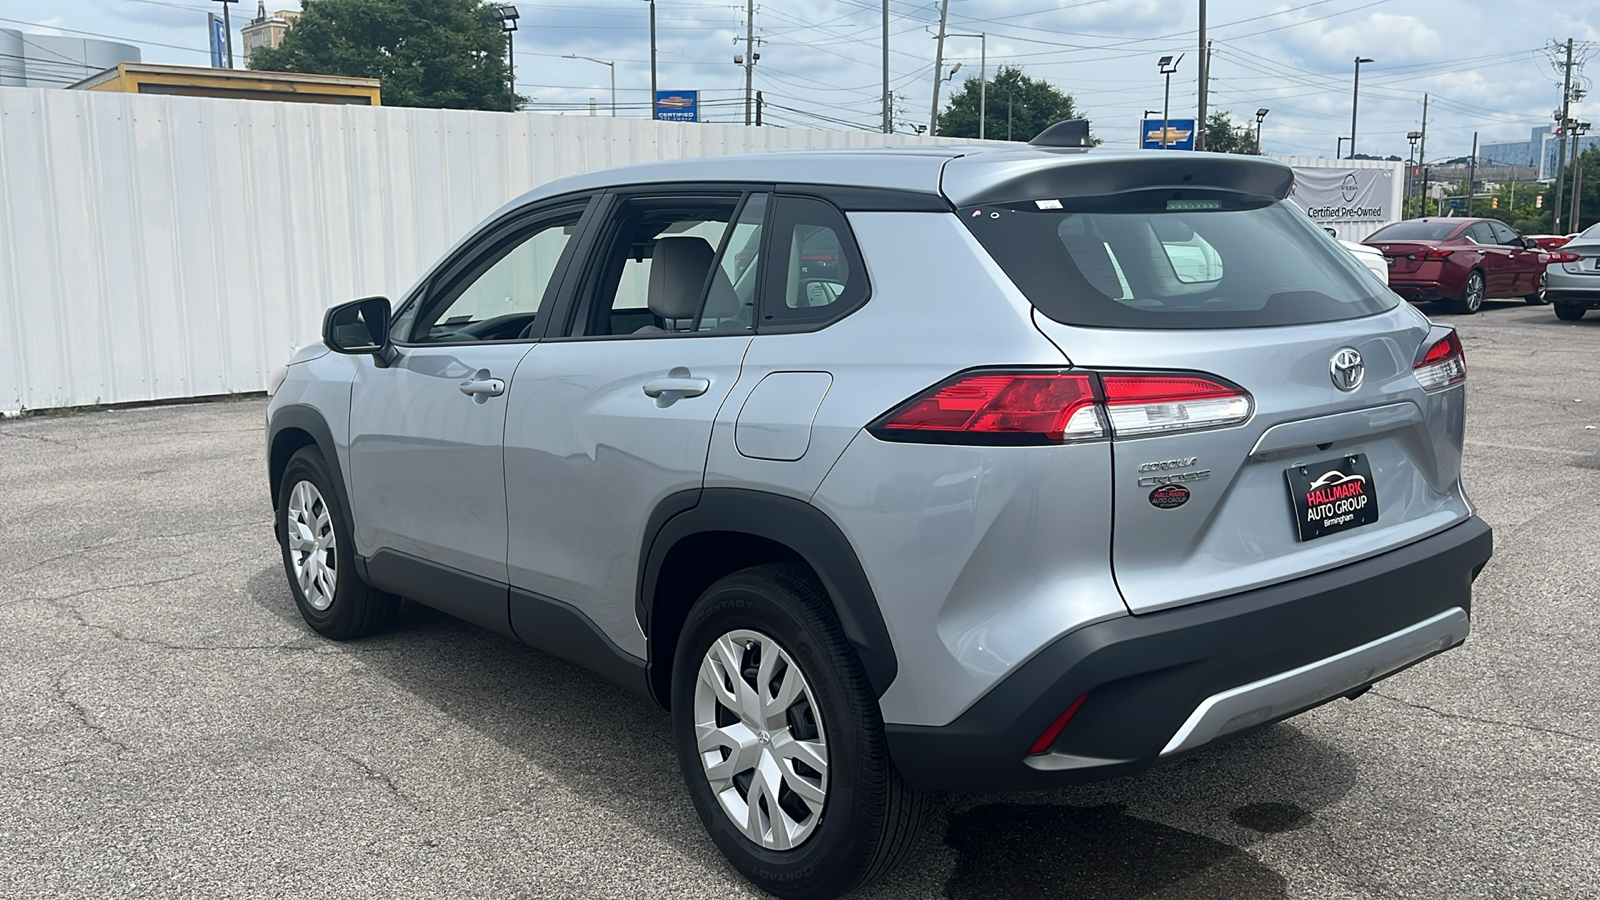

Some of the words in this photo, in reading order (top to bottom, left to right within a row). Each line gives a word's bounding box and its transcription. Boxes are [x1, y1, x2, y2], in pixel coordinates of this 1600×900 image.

[1307, 206, 1340, 218] Certified
[1341, 206, 1382, 217] Pre-Owned
[1138, 456, 1198, 473] COROLLA
[1138, 469, 1211, 487] CROSS
[1153, 491, 1186, 499] HALLMARK
[1306, 480, 1364, 506] HALLMARK
[1307, 504, 1334, 522] AUTO
[1335, 495, 1368, 514] GROUP
[1323, 513, 1354, 528] Birmingham
